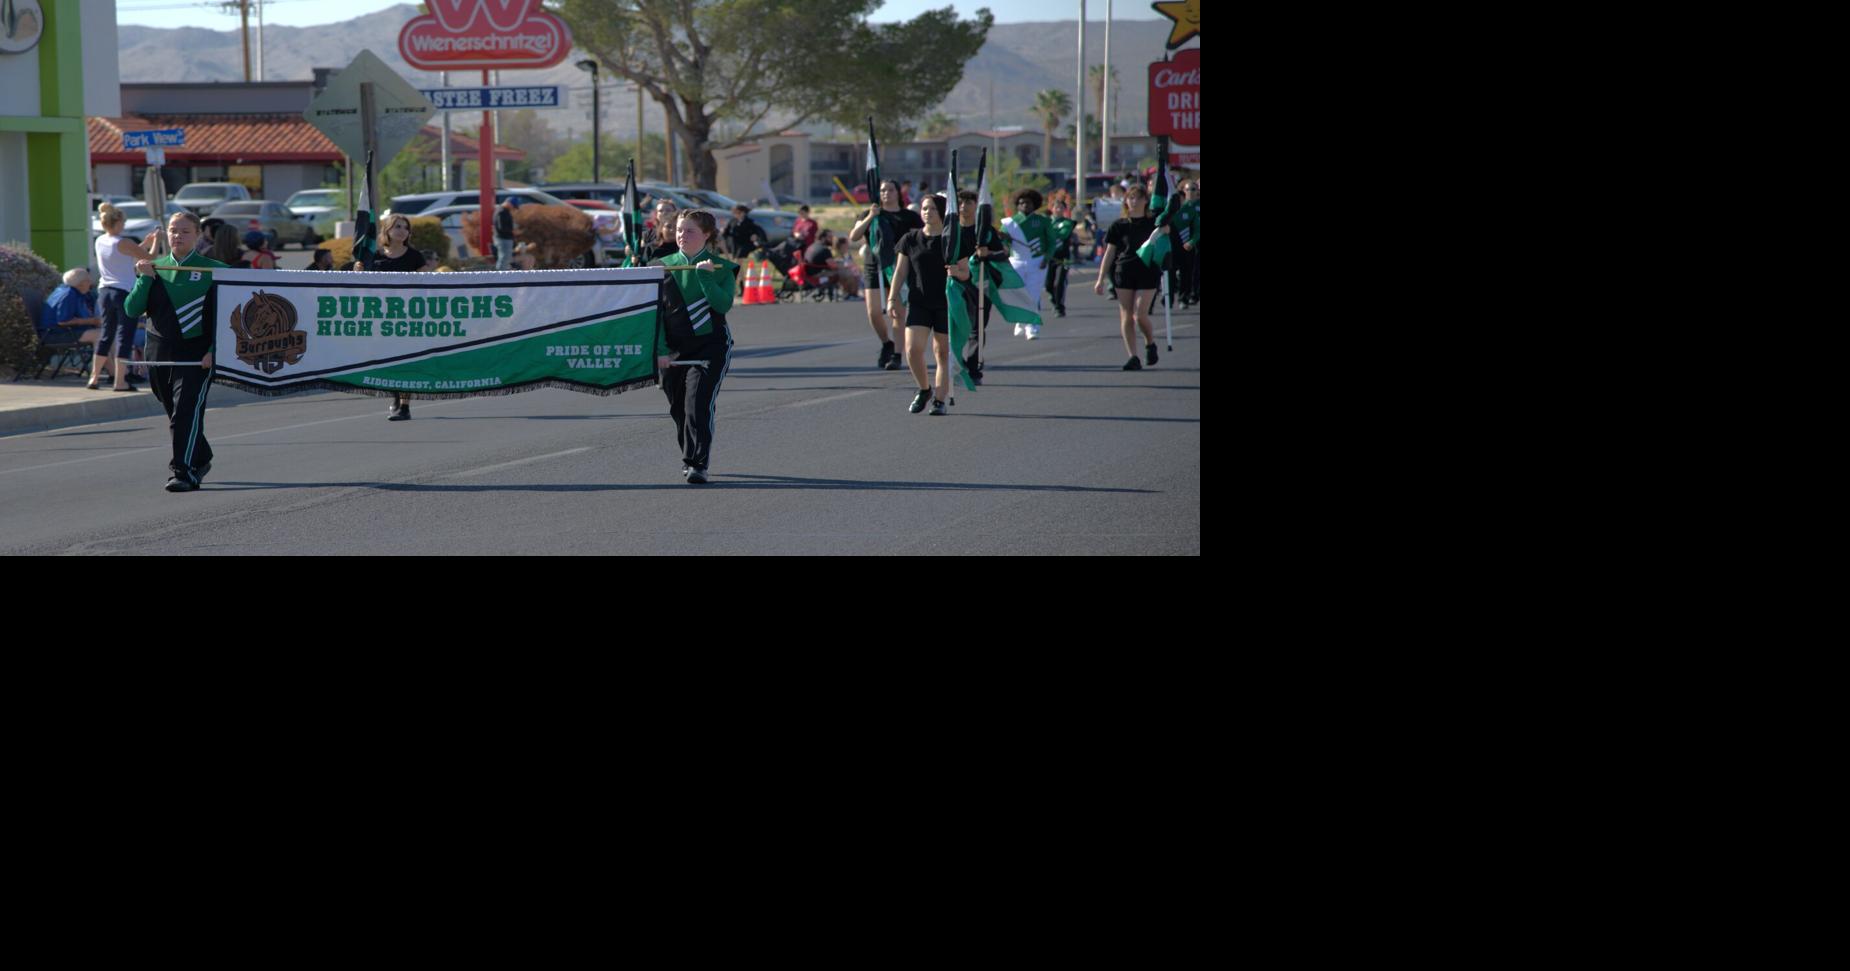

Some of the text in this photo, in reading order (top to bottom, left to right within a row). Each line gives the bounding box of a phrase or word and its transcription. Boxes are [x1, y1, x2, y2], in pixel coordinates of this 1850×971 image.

[412, 33, 553, 54] Wienerschnitzel
[488, 86, 554, 107] FREEZ
[124, 132, 149, 148] Park
[152, 131, 177, 145] View
[189, 271, 202, 281] B
[317, 295, 514, 319] BURROUGHS
[317, 320, 466, 337] HIGH SCHOOL
[546, 344, 643, 356] PRIDE OF THE
[566, 358, 622, 369] VALLEY
[363, 376, 502, 390] RIDGECREST, CALIFORNIA
